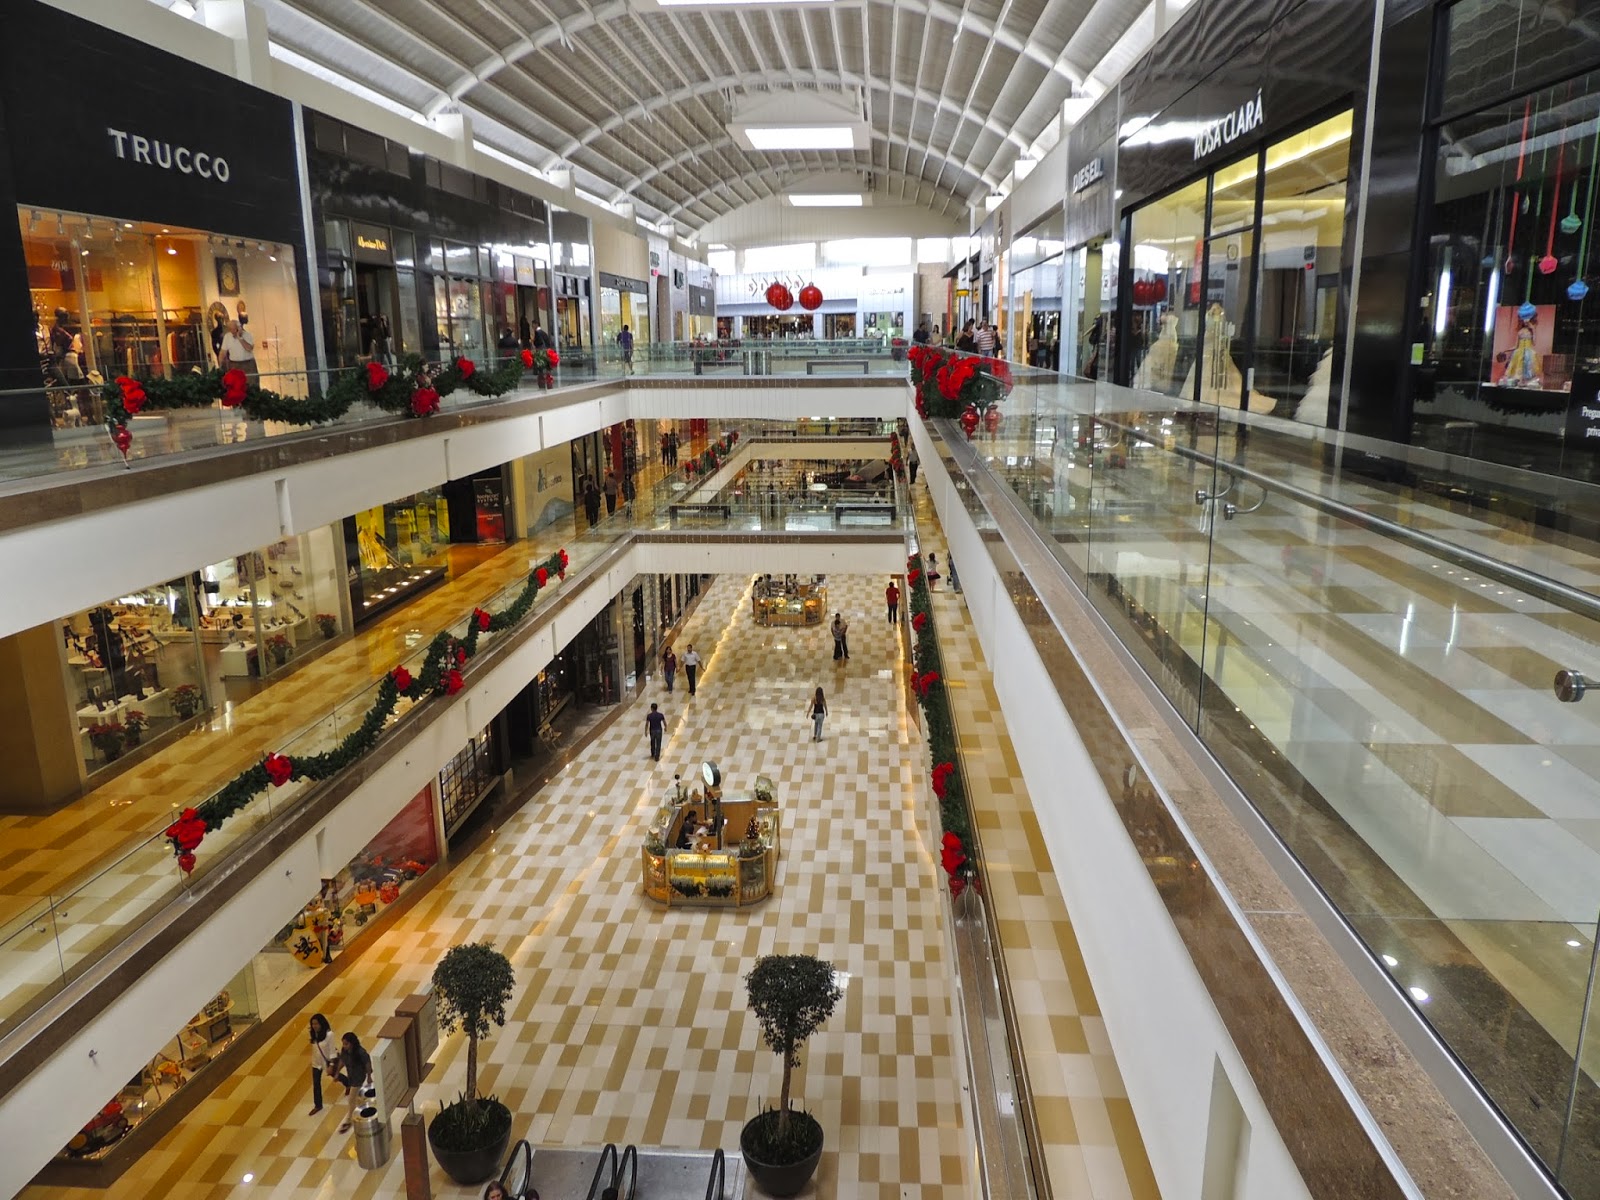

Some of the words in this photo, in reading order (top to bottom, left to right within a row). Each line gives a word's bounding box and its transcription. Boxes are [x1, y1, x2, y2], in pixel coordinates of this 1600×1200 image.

[1194, 118, 1222, 160] ROSA
[1223, 87, 1263, 144] CLARÁ
[107, 127, 230, 183] TRUCCO
[1073, 157, 1104, 195] DIESEL
